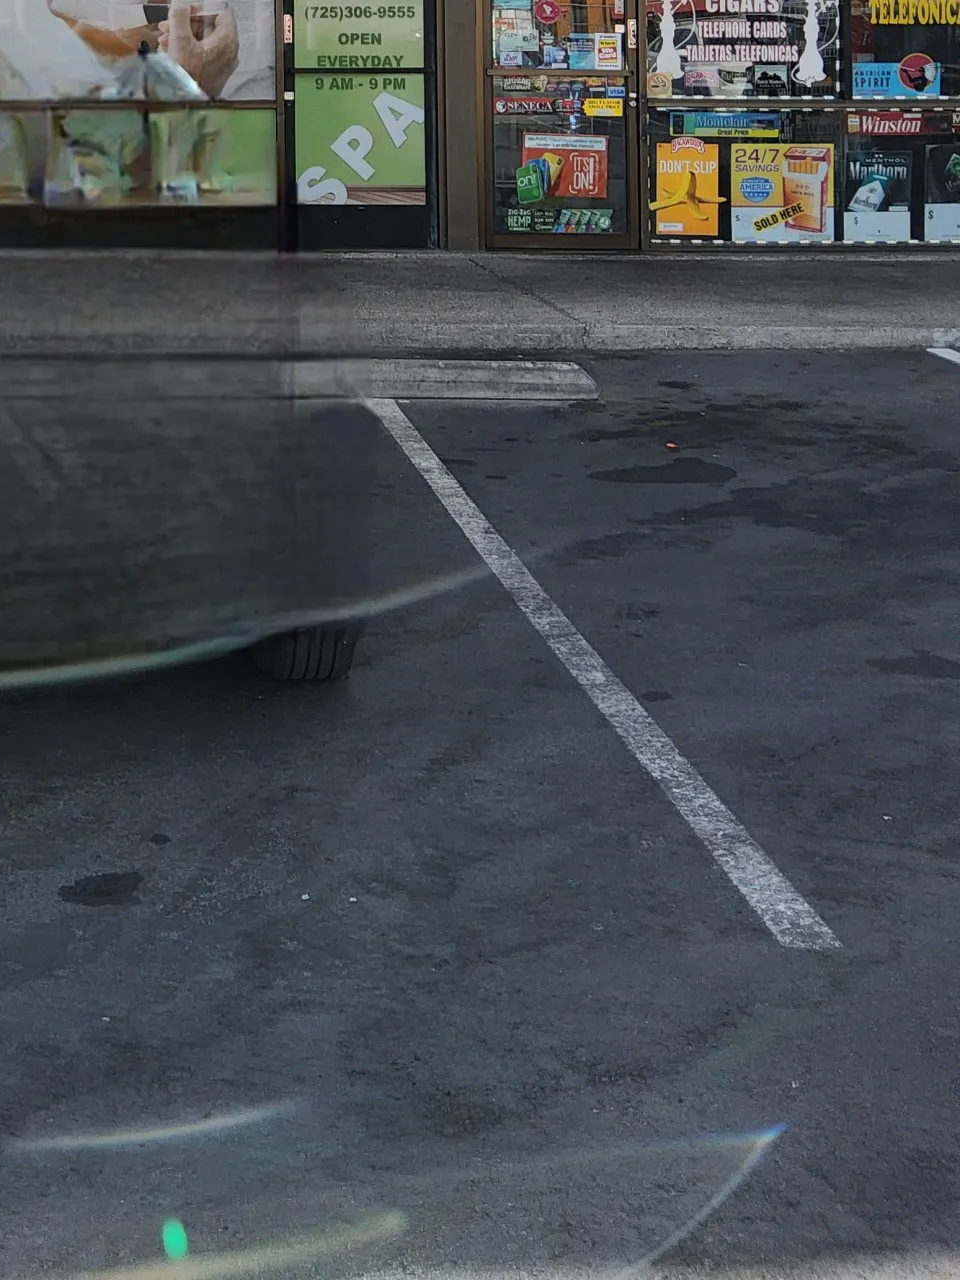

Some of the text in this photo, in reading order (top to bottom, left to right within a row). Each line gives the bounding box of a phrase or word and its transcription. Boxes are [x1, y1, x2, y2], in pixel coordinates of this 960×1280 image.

[304, 6, 415, 21] (725)306-9555
[697, 21, 787, 38] TELEPHONE CARDS
[338, 33, 382, 45] OPEN
[686, 45, 799, 62] TARJETAS TELEFONICAS
[317, 55, 404, 67] EVERYDAY
[314, 78, 325, 90] 9
[329, 78, 353, 90] AM
[369, 78, 378, 90] 9
[382, 78, 406, 90] PM
[854, 77, 891, 88] SPIRIT
[507, 101, 553, 110] SENECA
[696, 115, 749, 127] Montclair
[861, 116, 921, 133] Winston
[296, 91, 424, 205] SPA
[735, 148, 780, 163] 24/7
[660, 160, 716, 174] DON'T SLIP
[735, 164, 781, 173] SAVINGS
[849, 162, 907, 180] Marlboro
[740, 183, 773, 191] AMERICA
[508, 216, 531, 227] HEMP
[754, 202, 805, 231] SOLD HERE
